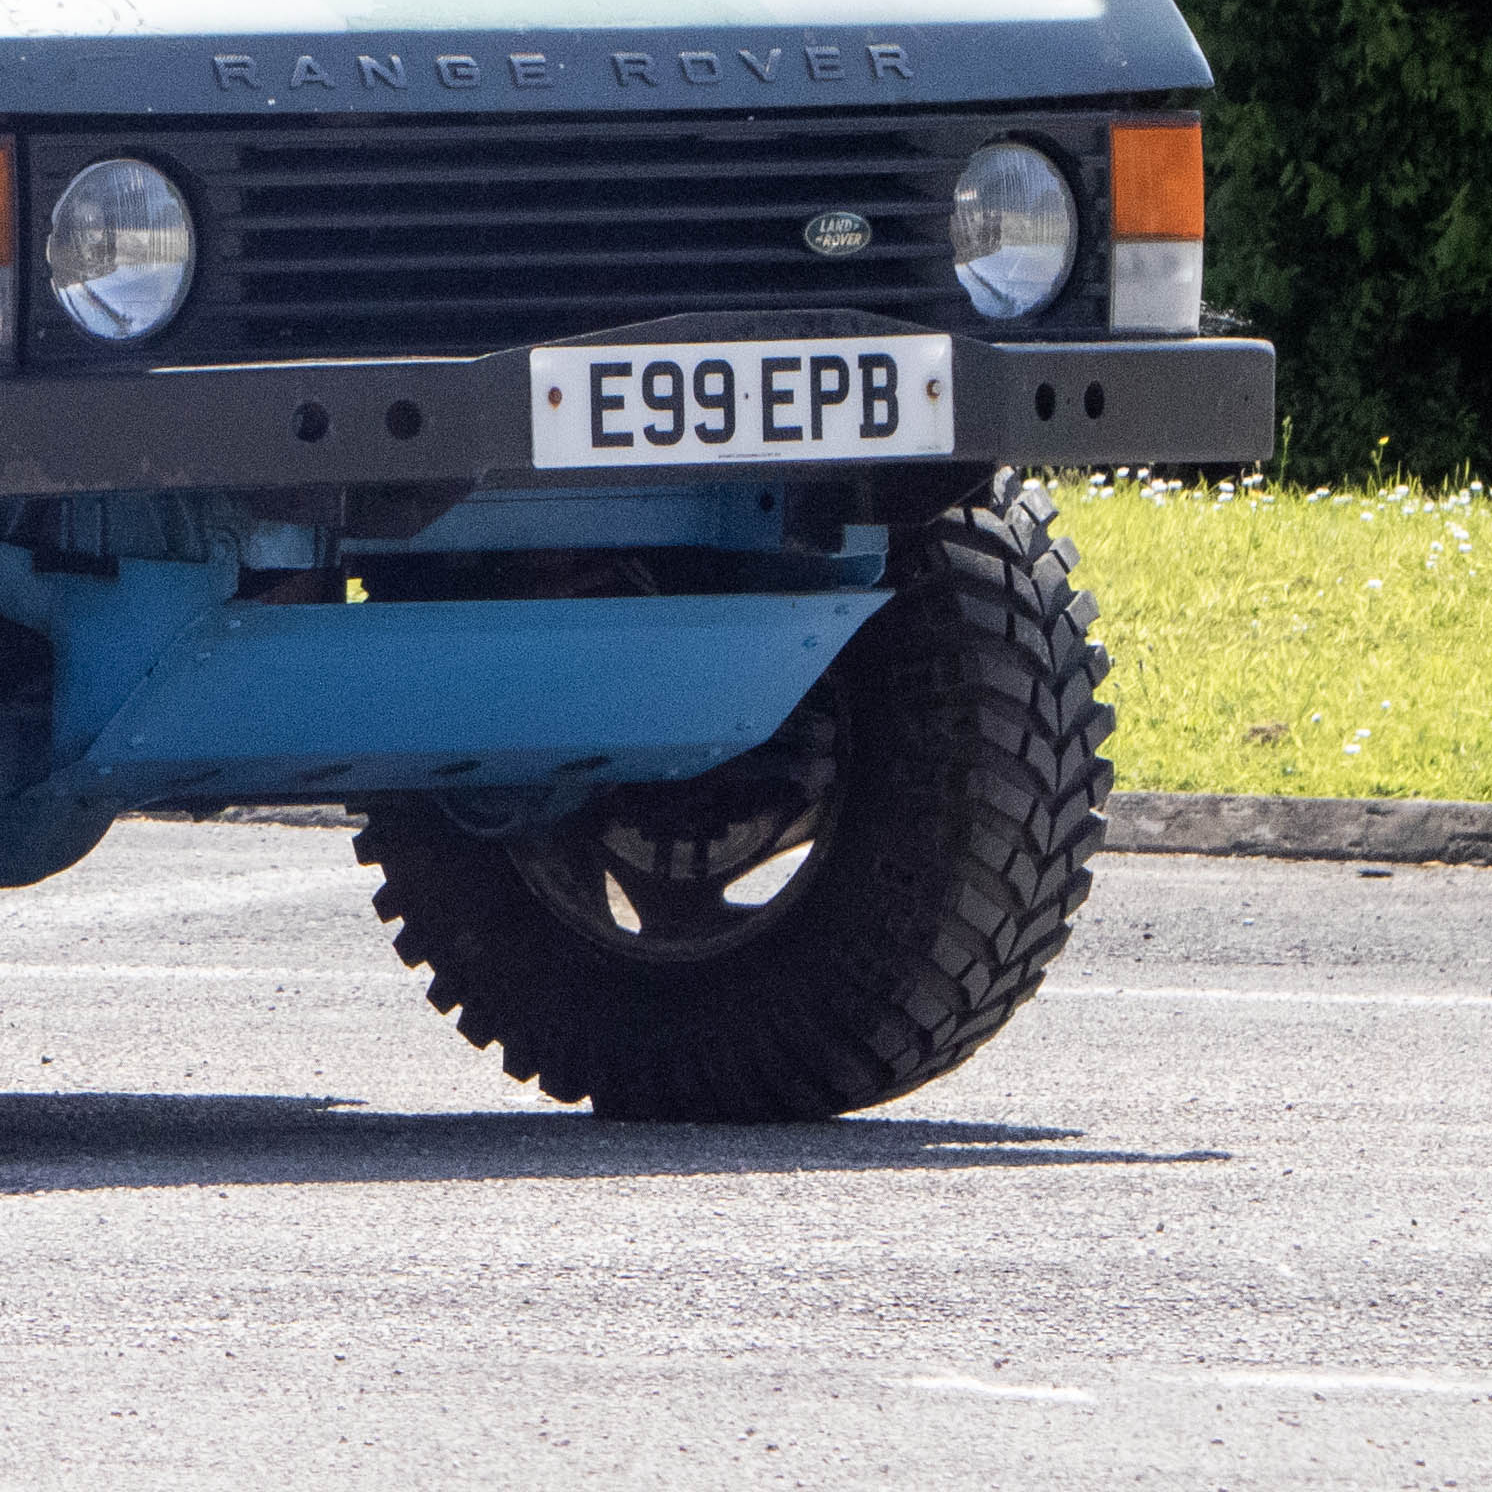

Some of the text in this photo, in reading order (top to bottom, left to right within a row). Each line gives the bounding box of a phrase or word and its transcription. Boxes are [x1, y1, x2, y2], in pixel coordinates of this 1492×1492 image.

[214, 43, 916, 91] RANGE ROVER
[819, 218, 853, 234] LAND
[822, 232, 863, 248] ROVER
[589, 352, 901, 449] E99 EPB
